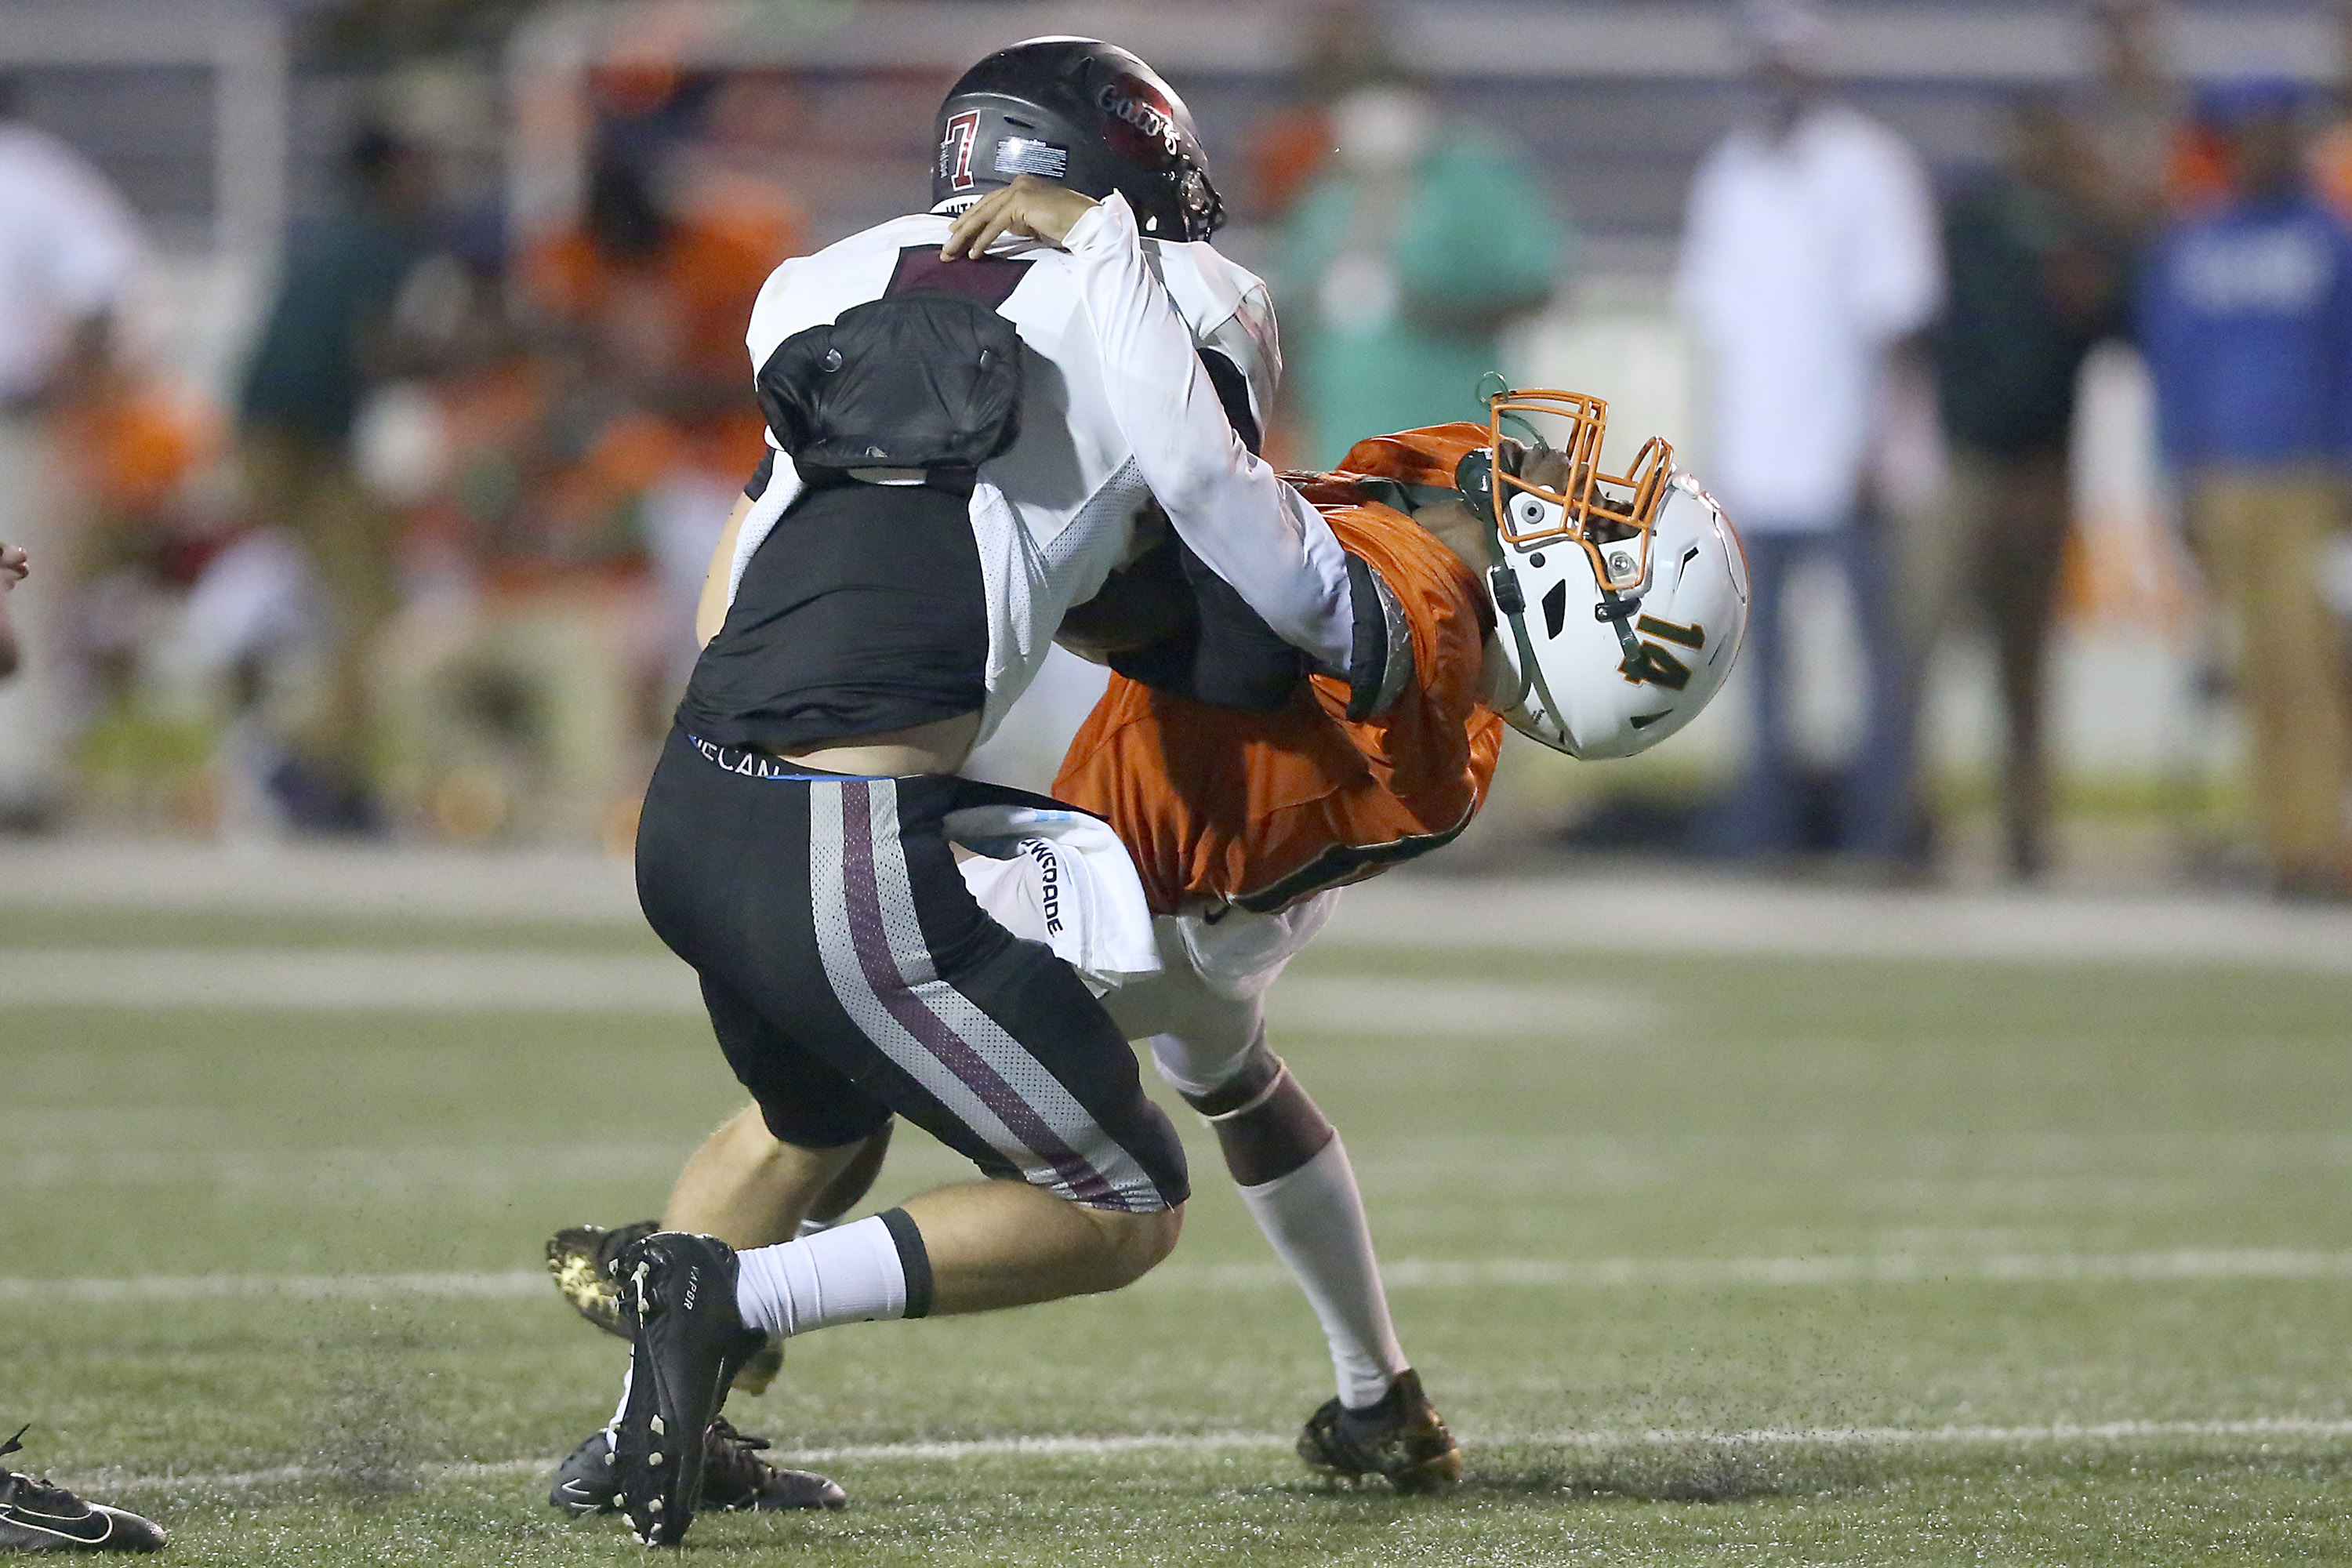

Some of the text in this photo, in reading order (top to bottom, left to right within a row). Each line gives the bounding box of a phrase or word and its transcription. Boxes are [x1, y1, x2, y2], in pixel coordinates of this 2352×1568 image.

[945, 109, 981, 192] 7
[1617, 614, 1705, 691] 14
[684, 1265, 700, 1310] VAPOR
